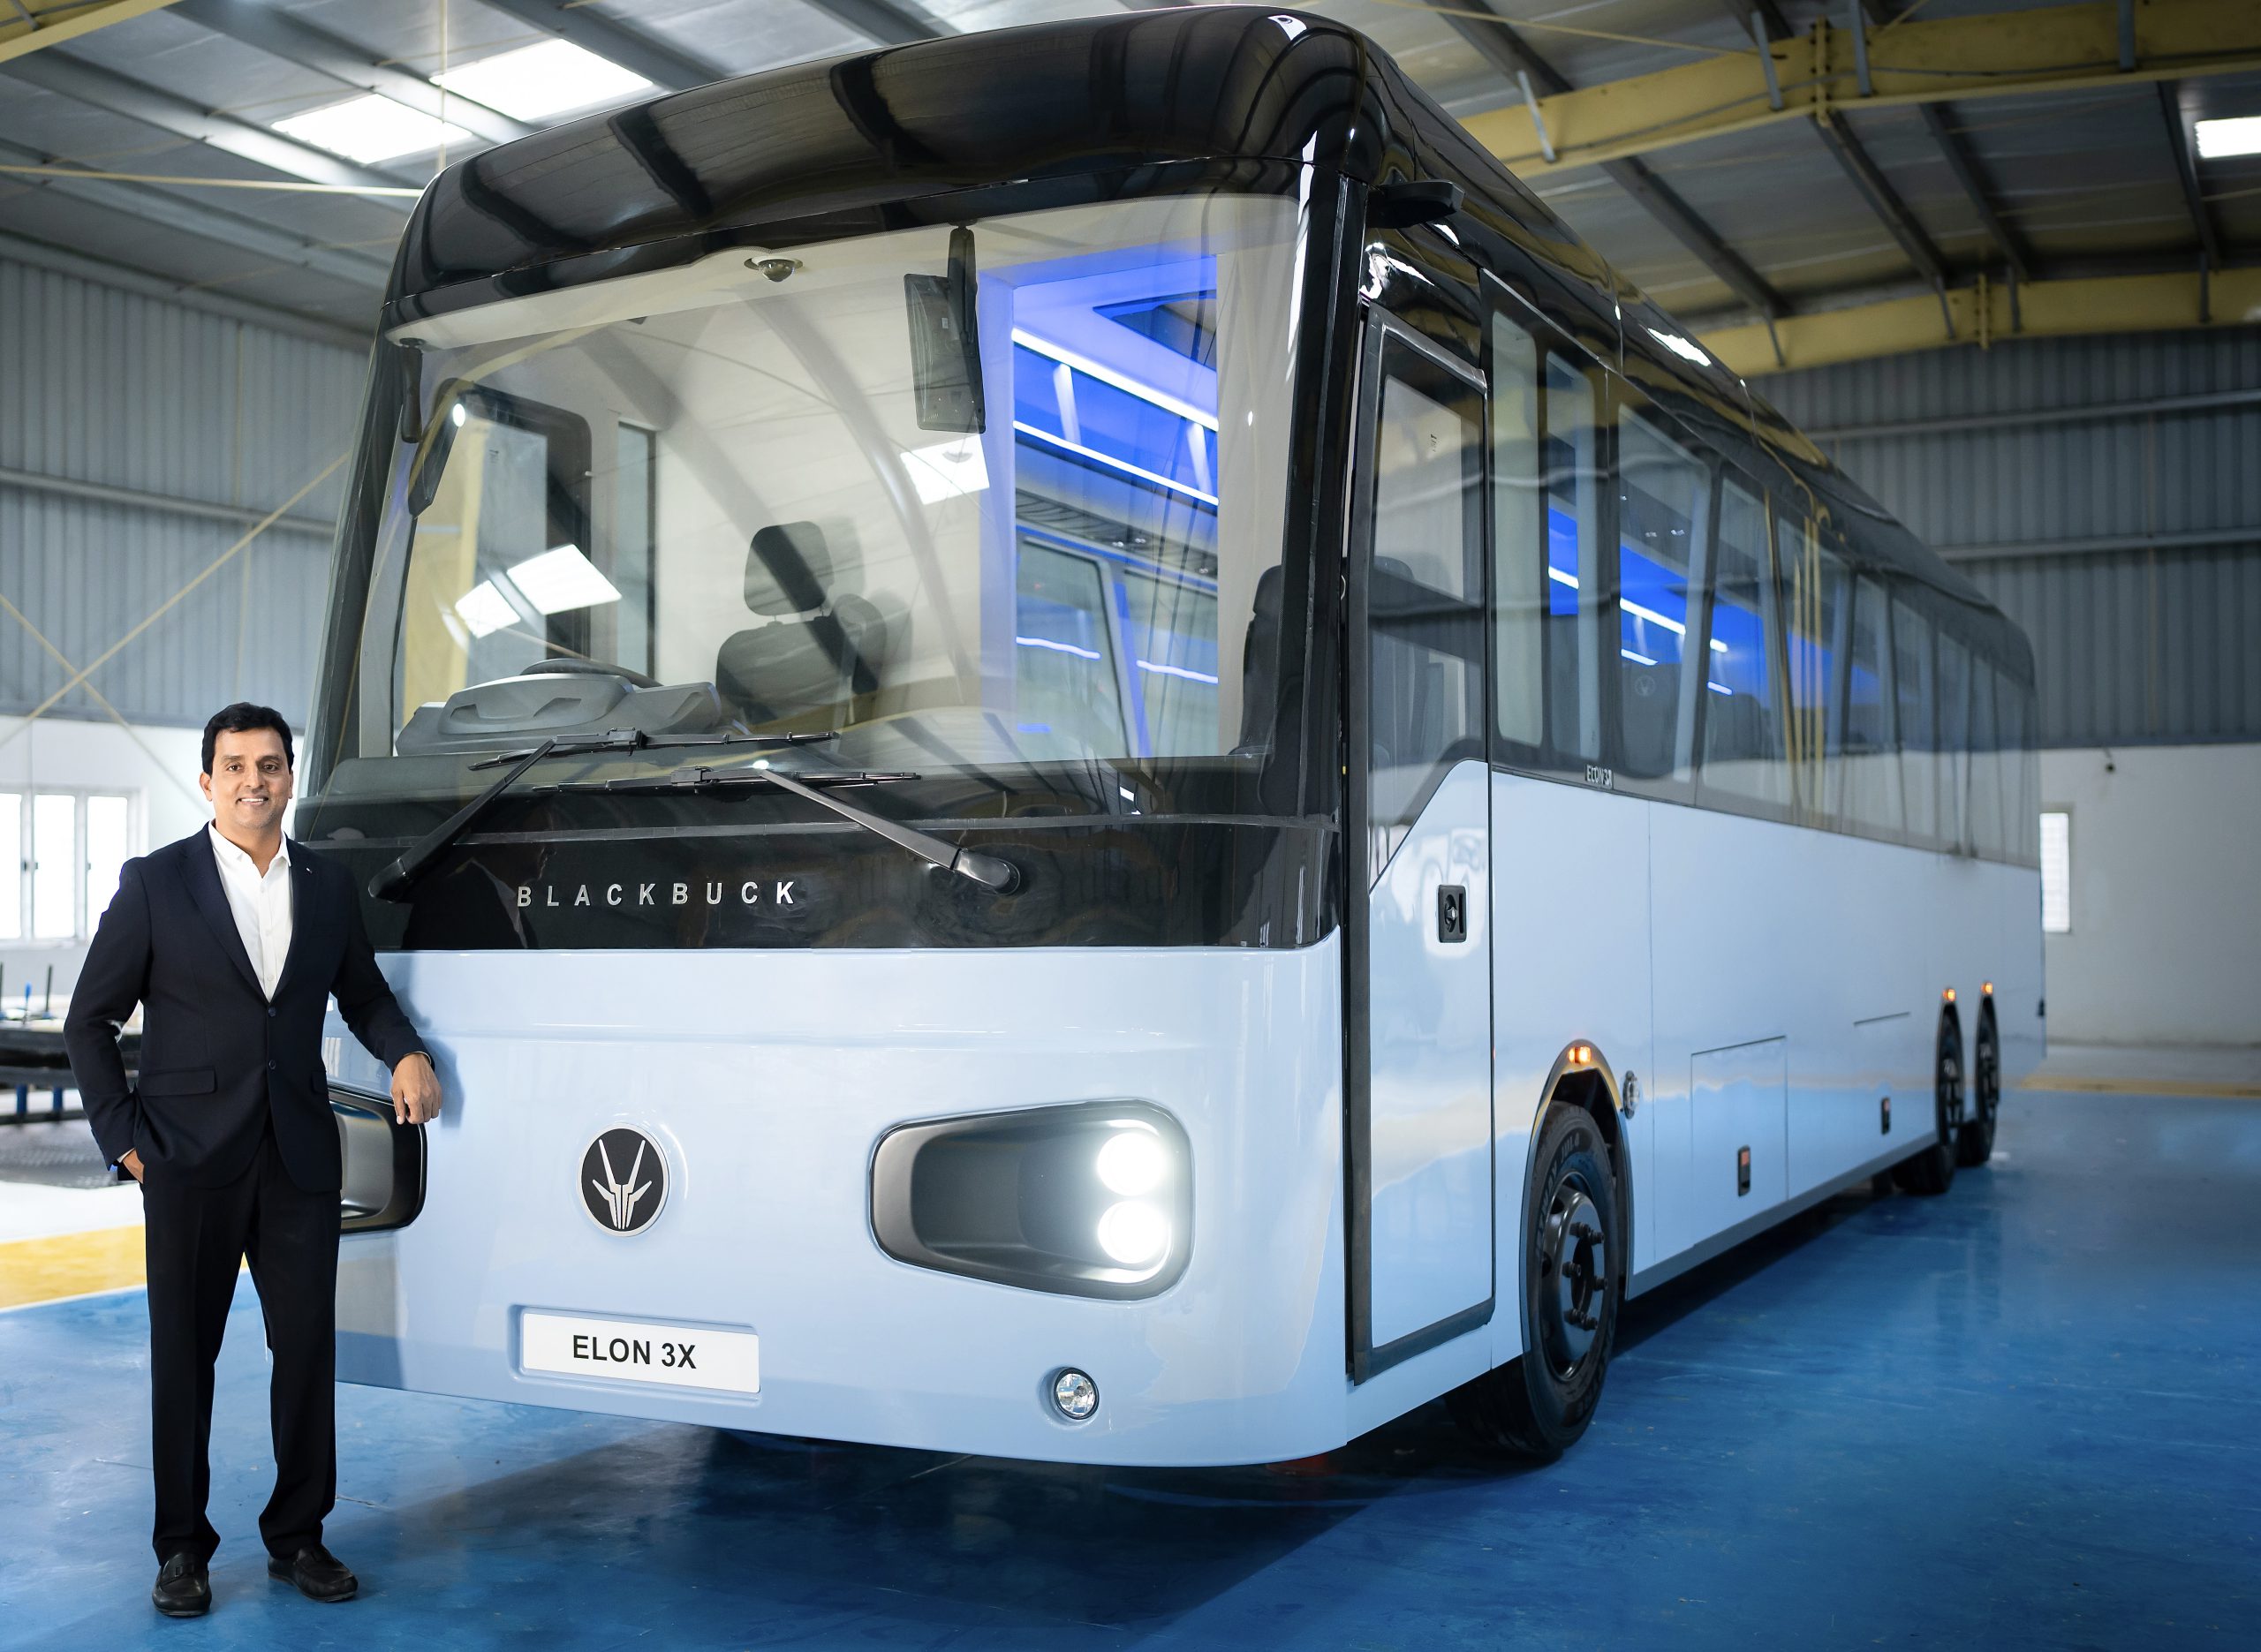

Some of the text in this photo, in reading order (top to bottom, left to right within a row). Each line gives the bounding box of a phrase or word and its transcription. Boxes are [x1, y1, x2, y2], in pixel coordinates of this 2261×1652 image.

[517, 881, 794, 908] BLACKBUCK
[573, 1334, 697, 1369] ELON 3X
